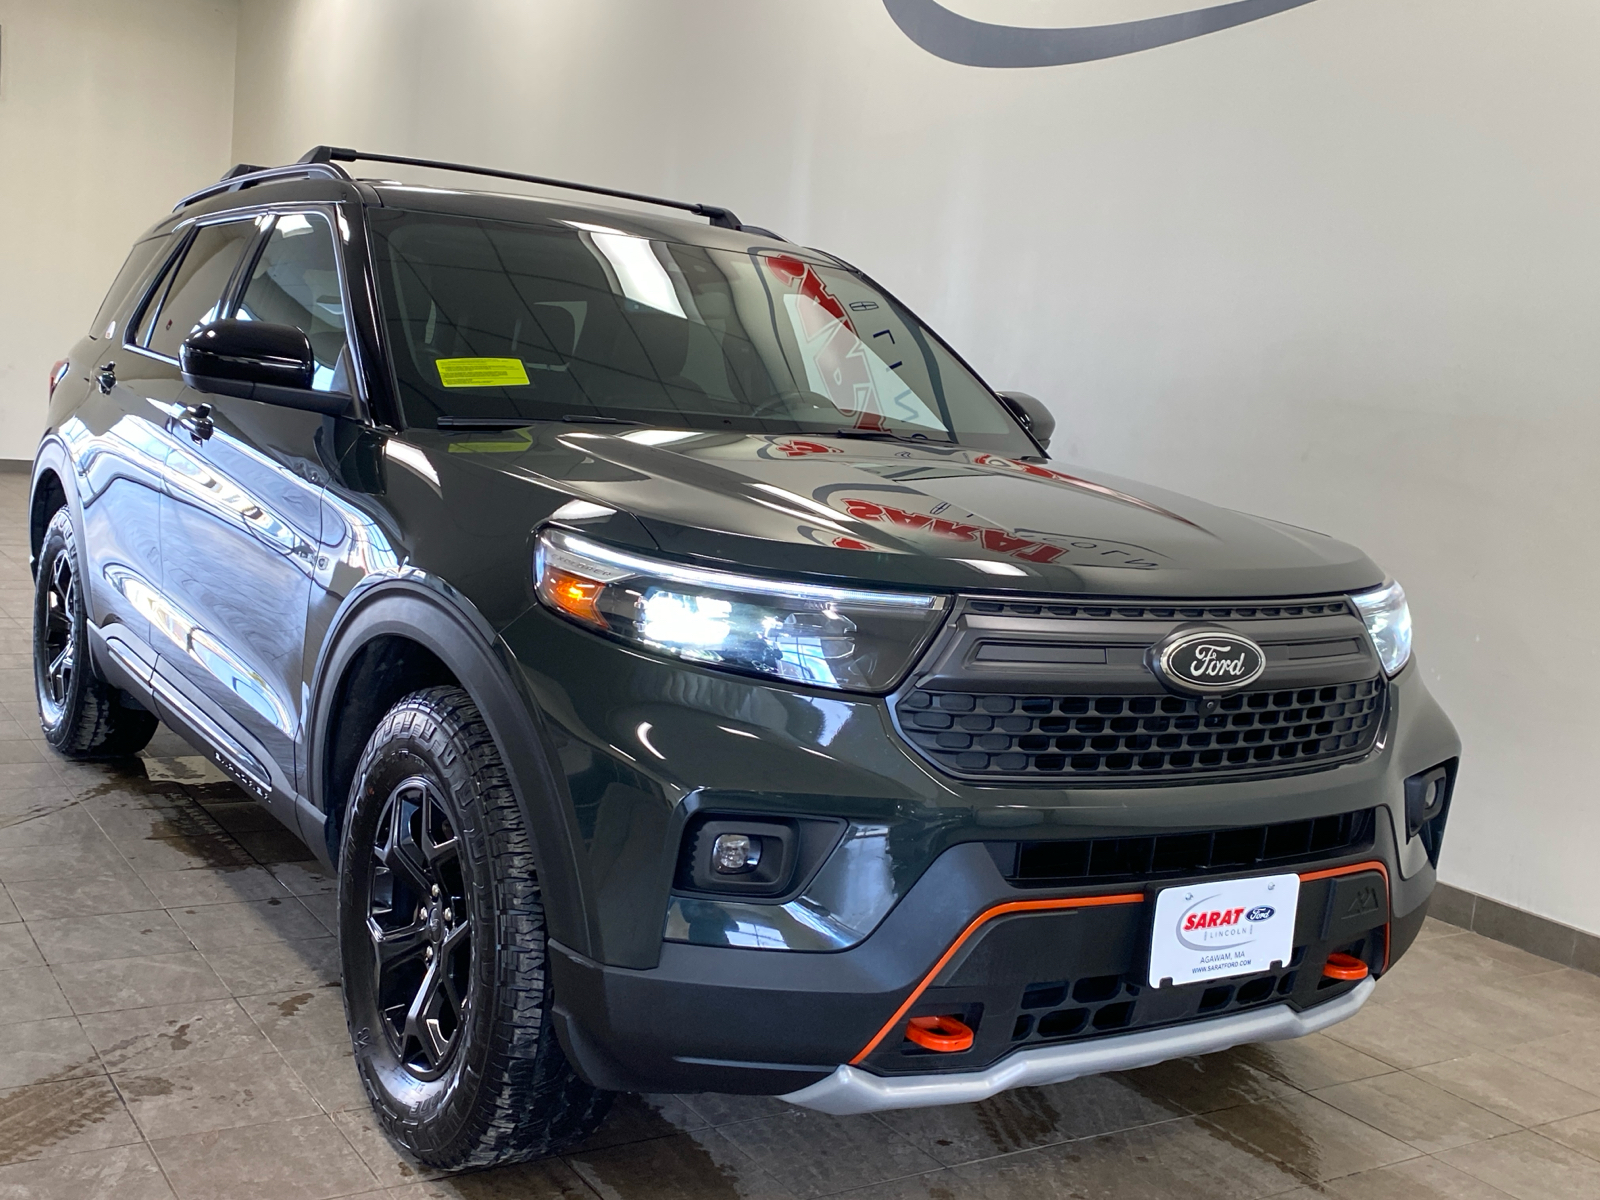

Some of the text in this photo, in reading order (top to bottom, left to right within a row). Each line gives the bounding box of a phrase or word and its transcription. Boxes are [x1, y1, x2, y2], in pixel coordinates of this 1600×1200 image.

[1190, 644, 1246, 677] Ford
[1183, 906, 1272, 932] SARAT Ford
[1209, 927, 1247, 939] LINCOLN
[1199, 950, 1246, 964] AGAWAM, MA
[1192, 959, 1252, 974] WWW.SARATFORD.COM
